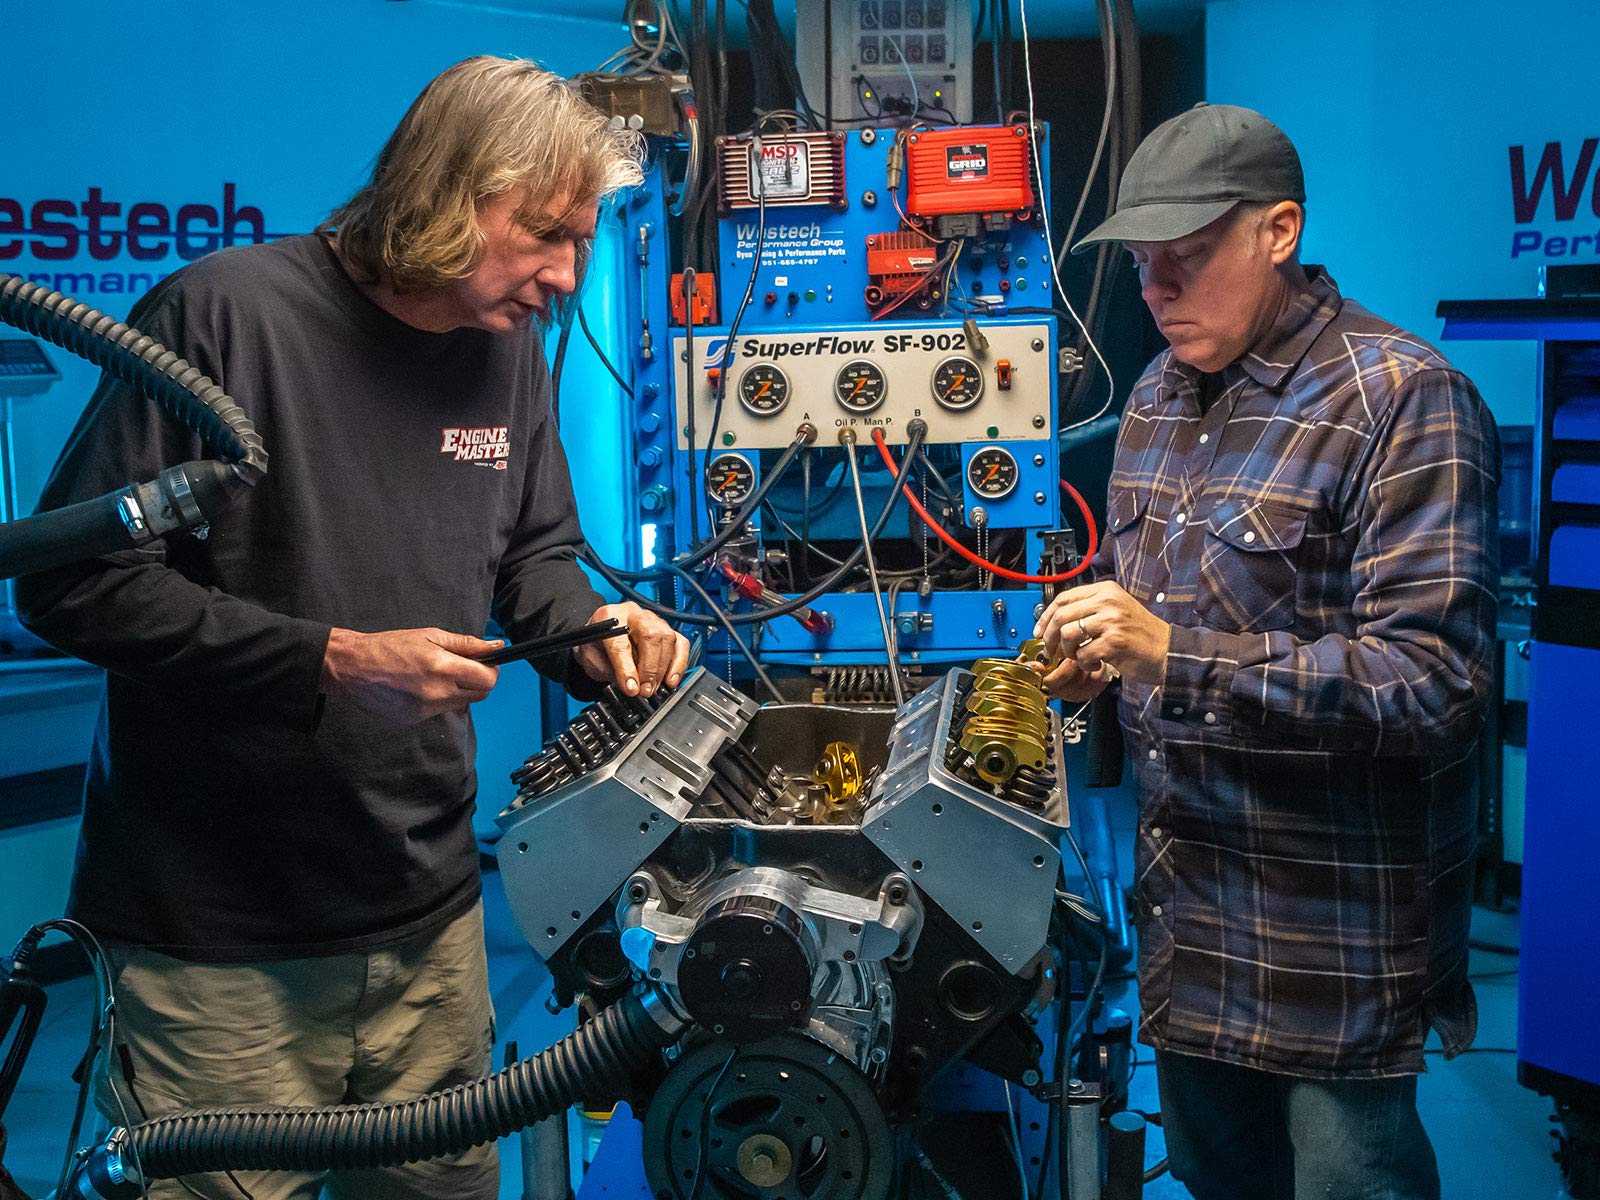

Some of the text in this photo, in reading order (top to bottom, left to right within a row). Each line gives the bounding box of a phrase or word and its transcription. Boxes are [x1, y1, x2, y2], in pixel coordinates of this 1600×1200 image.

[761, 145, 797, 159] MSD
[949, 158, 986, 169] GRID
[1508, 137, 1600, 224] W
[737, 238, 844, 249] Perormance Group
[785, 248, 827, 257] Performance
[828, 247, 846, 255] Parts
[742, 333, 966, 361] SuperFlow SF-902
[803, 412, 811, 420] A
[914, 408, 922, 417] B
[834, 418, 858, 427] Oil P.
[864, 417, 894, 426] Man P.
[441, 426, 508, 453] ENGINE
